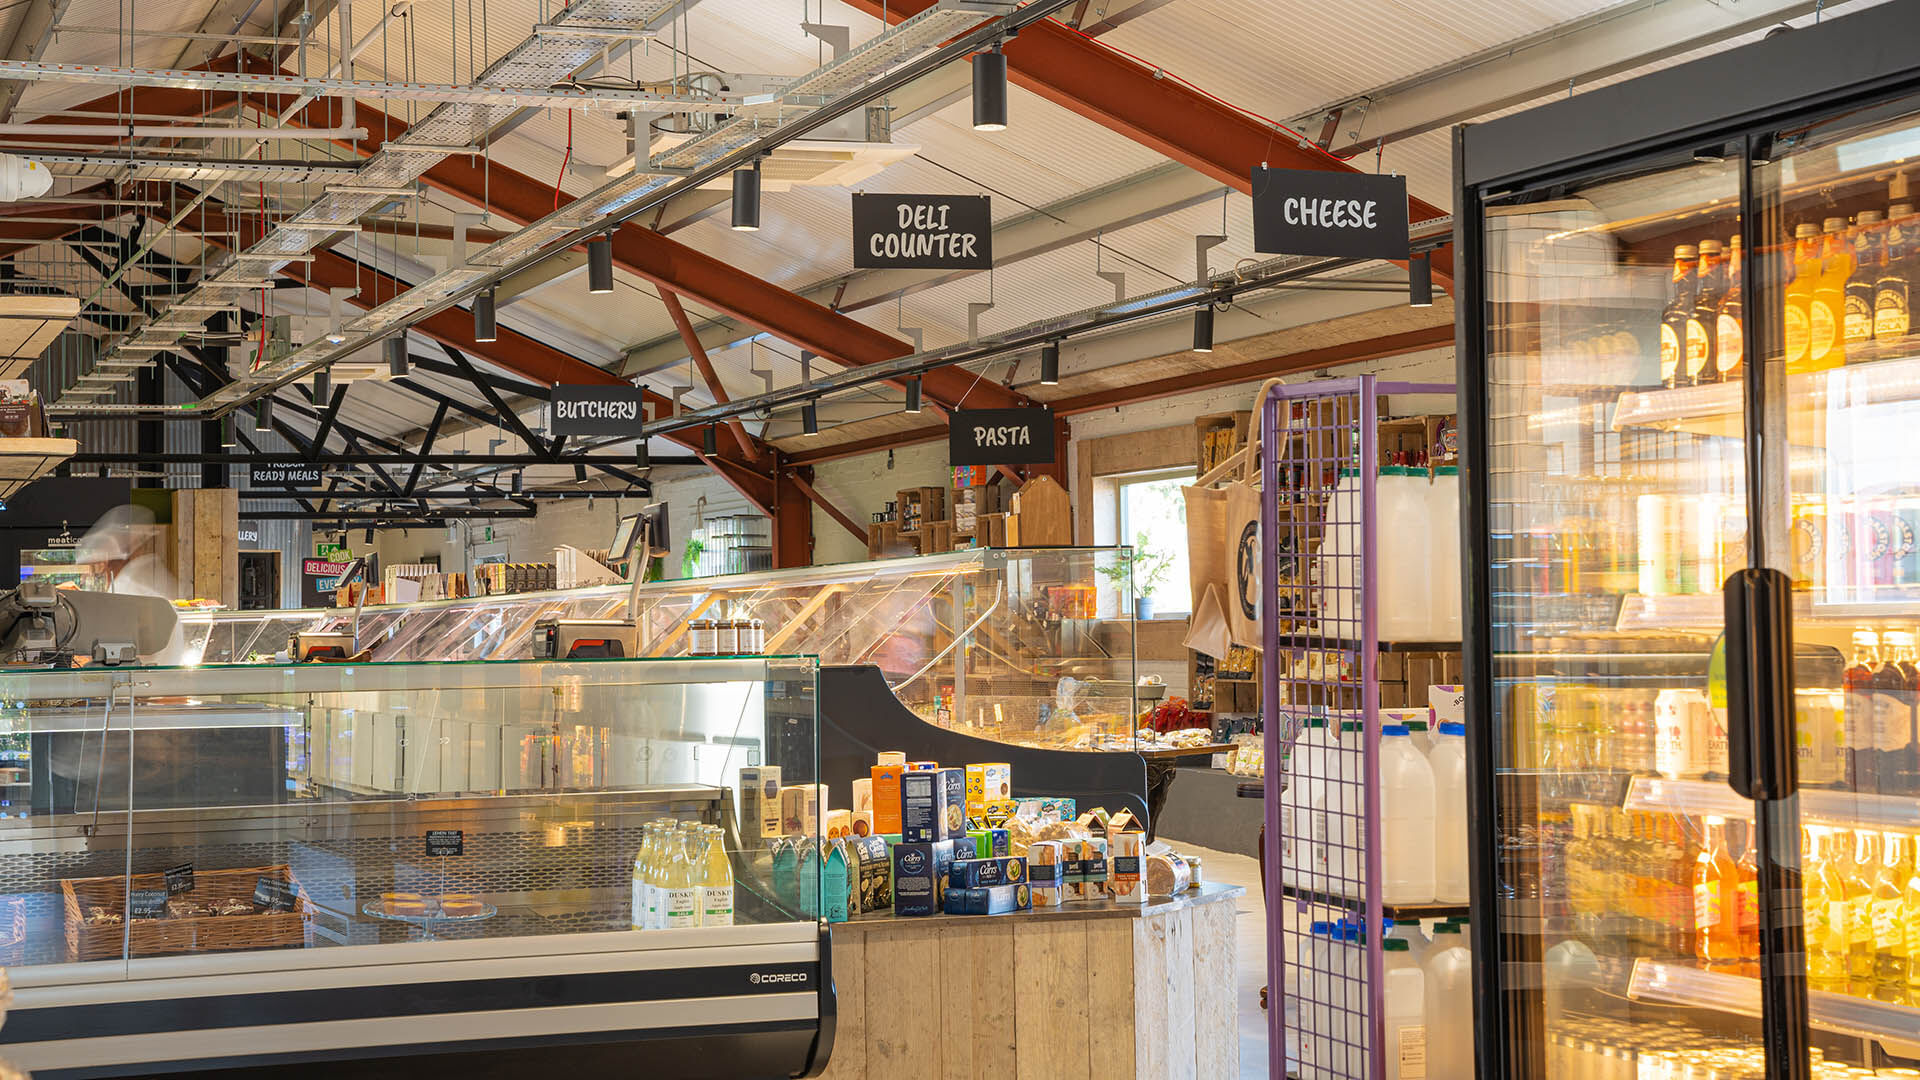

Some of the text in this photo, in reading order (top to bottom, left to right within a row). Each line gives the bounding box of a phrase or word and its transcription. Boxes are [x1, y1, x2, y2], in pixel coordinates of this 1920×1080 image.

[897, 203, 951, 231] DELI
[1283, 197, 1377, 229] CHEESE
[870, 232, 978, 258] COUNTER
[556, 400, 637, 420] BUTCHERY
[973, 425, 1031, 447] PASTA
[253, 470, 320, 481] READY MEALS
[329, 550, 352, 562] COOK
[306, 562, 346, 575] DELICIOUS
[761, 973, 807, 983] CORECO
